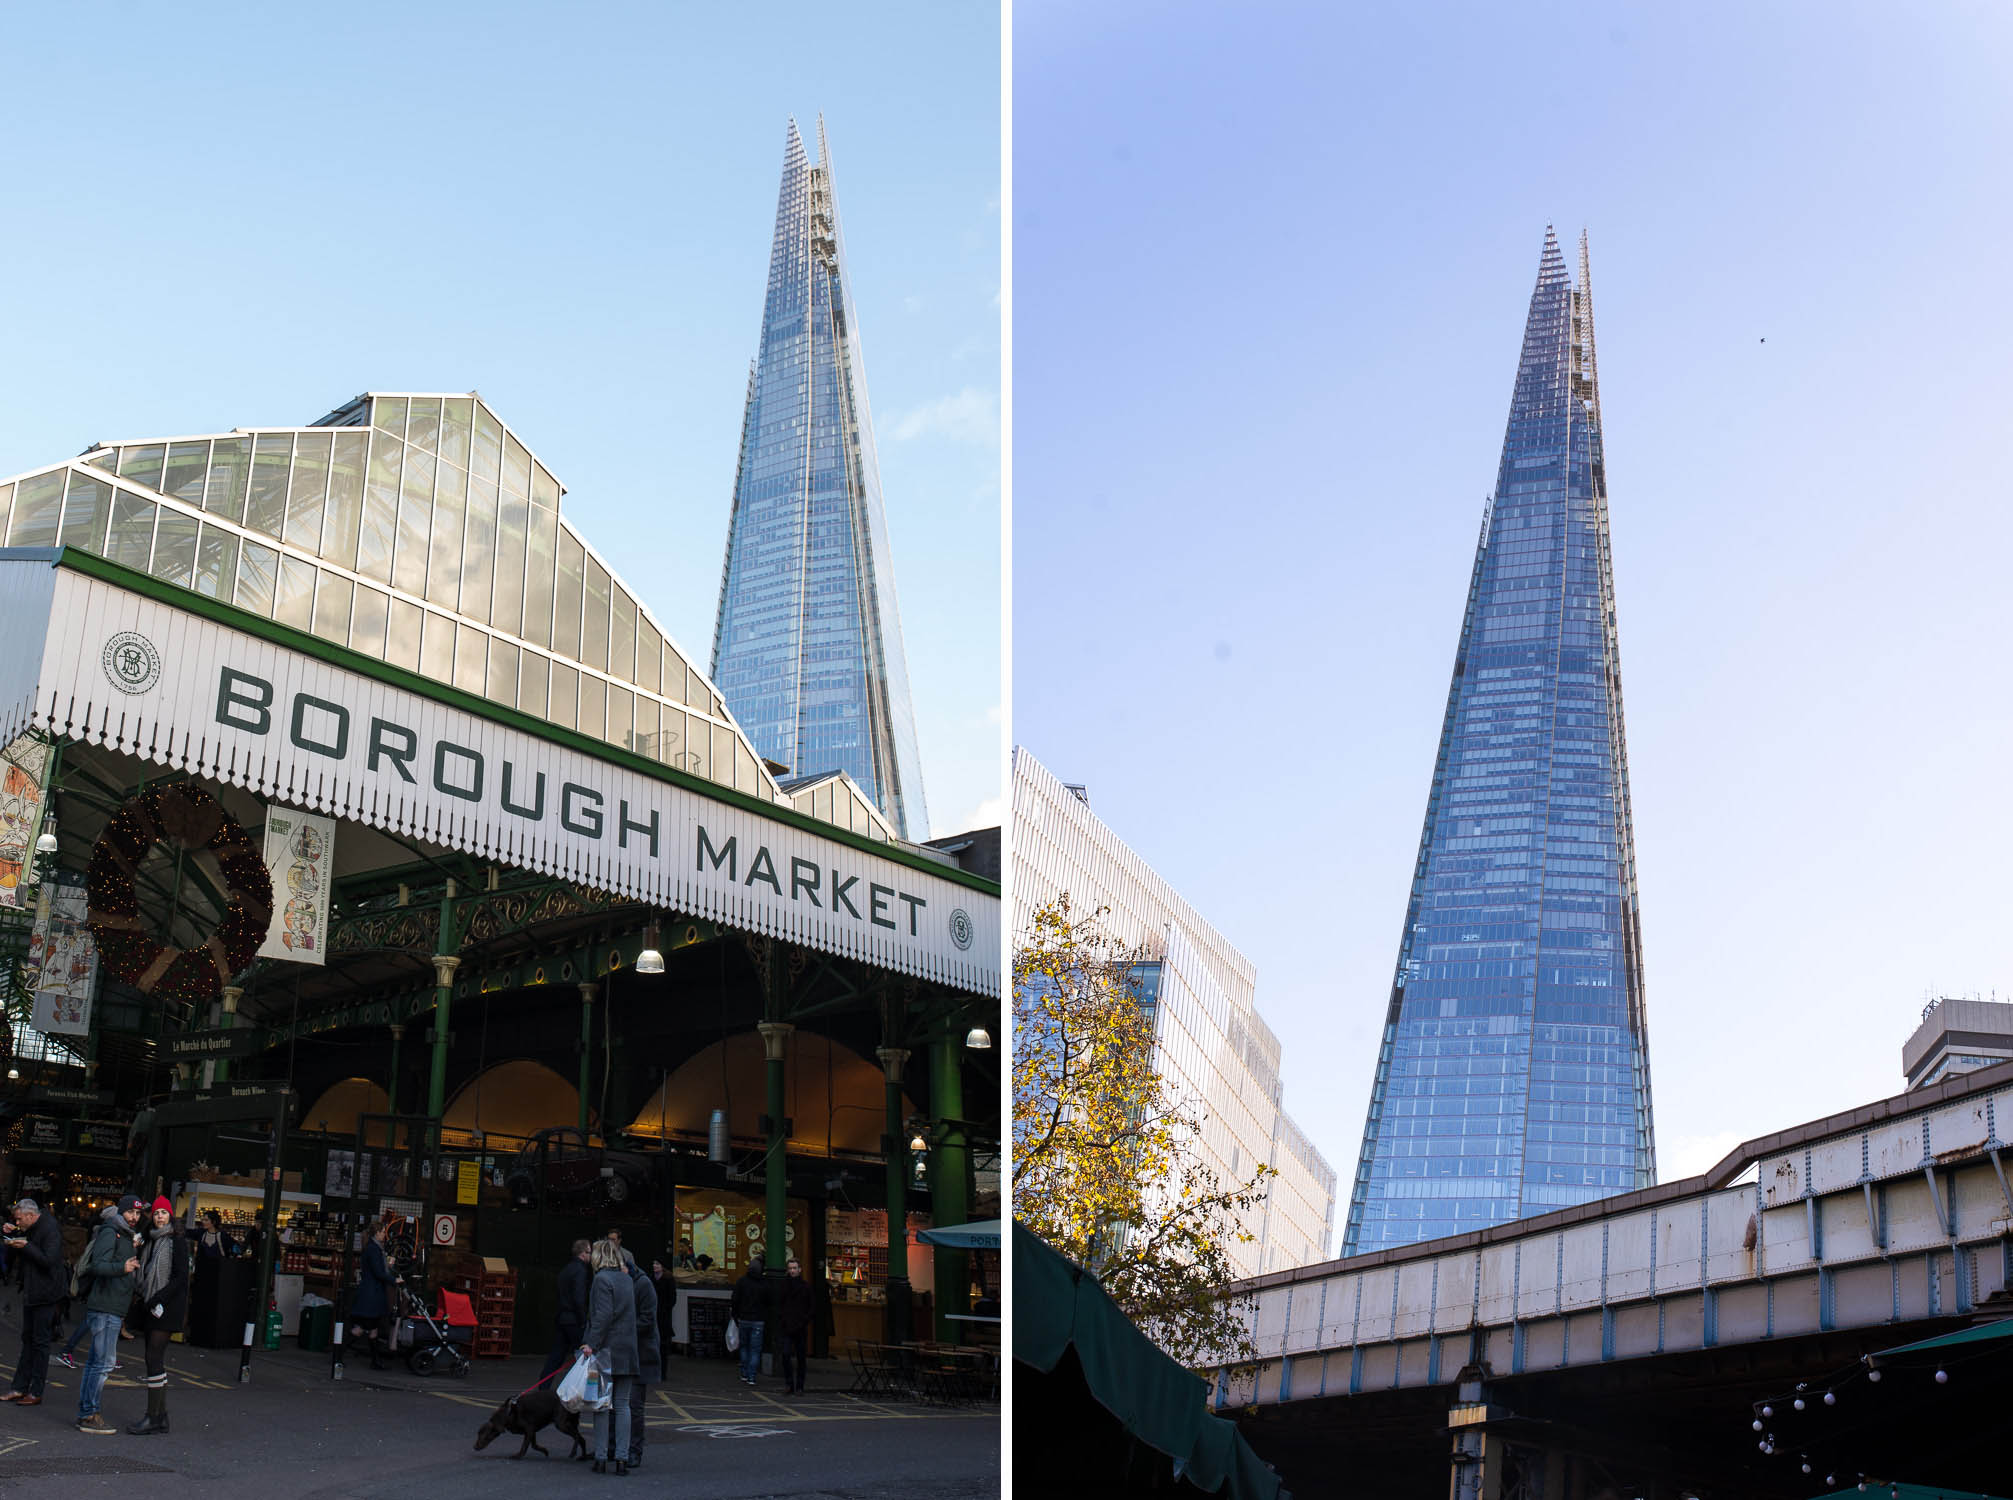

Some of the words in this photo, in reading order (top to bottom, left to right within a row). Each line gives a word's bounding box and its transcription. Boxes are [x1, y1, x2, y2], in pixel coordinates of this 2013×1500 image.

[106, 635, 138, 666] BOROUGH
[141, 641, 158, 680] MARKET
[216, 665, 660, 858] BOROUGH
[696, 825, 927, 937] MARKET
[316, 912, 325, 953] CELEBRATING
[322, 832, 330, 871] SOUTHWARK
[172, 1040, 179, 1052] Le
[208, 1036, 231, 1050] Quartier
[441, 1223, 449, 1235] 5
